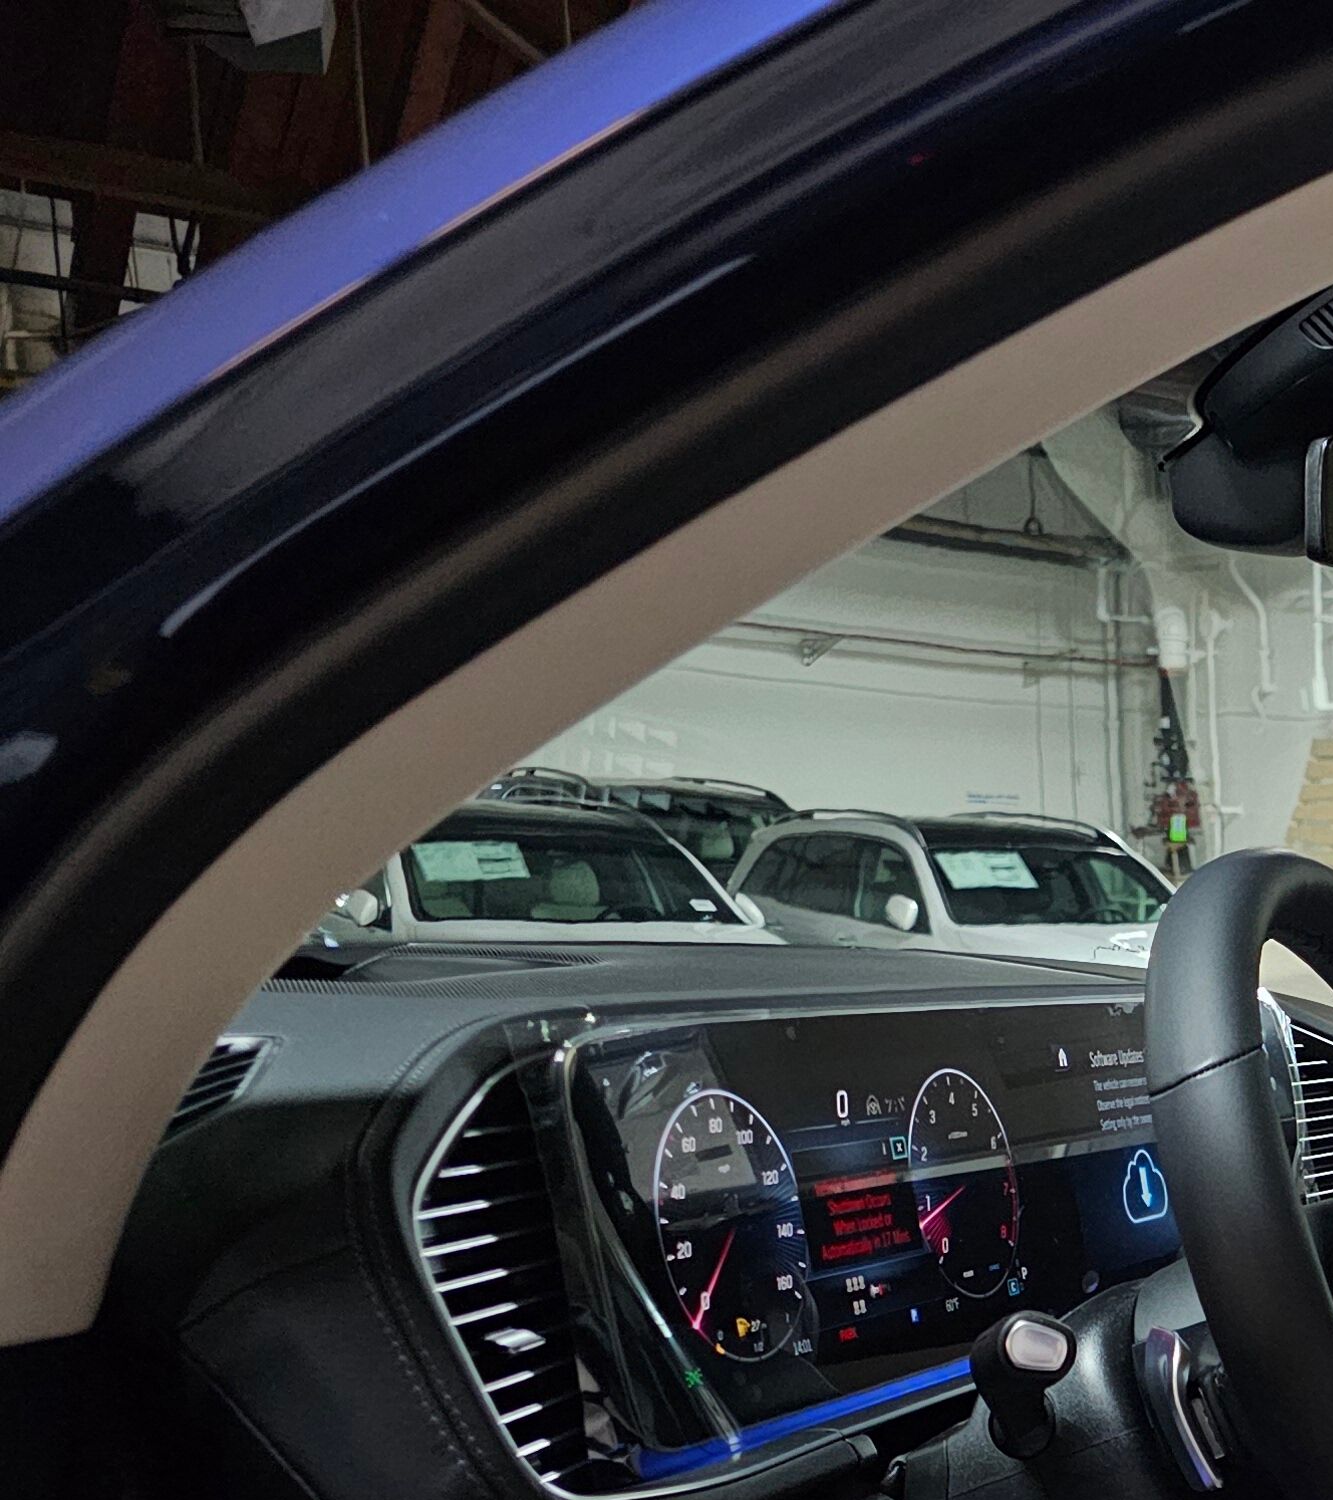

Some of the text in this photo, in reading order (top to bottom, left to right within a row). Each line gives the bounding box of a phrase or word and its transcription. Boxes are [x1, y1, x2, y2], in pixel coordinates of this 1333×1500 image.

[1089, 1048, 1145, 1068] Software Updates
[836, 1089, 848, 1118] 0
[949, 1092, 955, 1105] 4
[929, 1110, 936, 1124] 3
[972, 1103, 978, 1117] 5
[709, 1117, 723, 1133] 80
[681, 1136, 697, 1153] 60
[736, 1130, 753, 1145] 100
[991, 1136, 997, 1150] 6
[921, 1147, 928, 1162] 2
[761, 1170, 779, 1186] 120
[670, 1182, 686, 1200] 40
[776, 1223, 793, 1239] 140
[676, 1240, 693, 1260] 20
[942, 1237, 949, 1254] 0
[1020, 1267, 1028, 1280] P
[776, 1275, 793, 1291] 160
